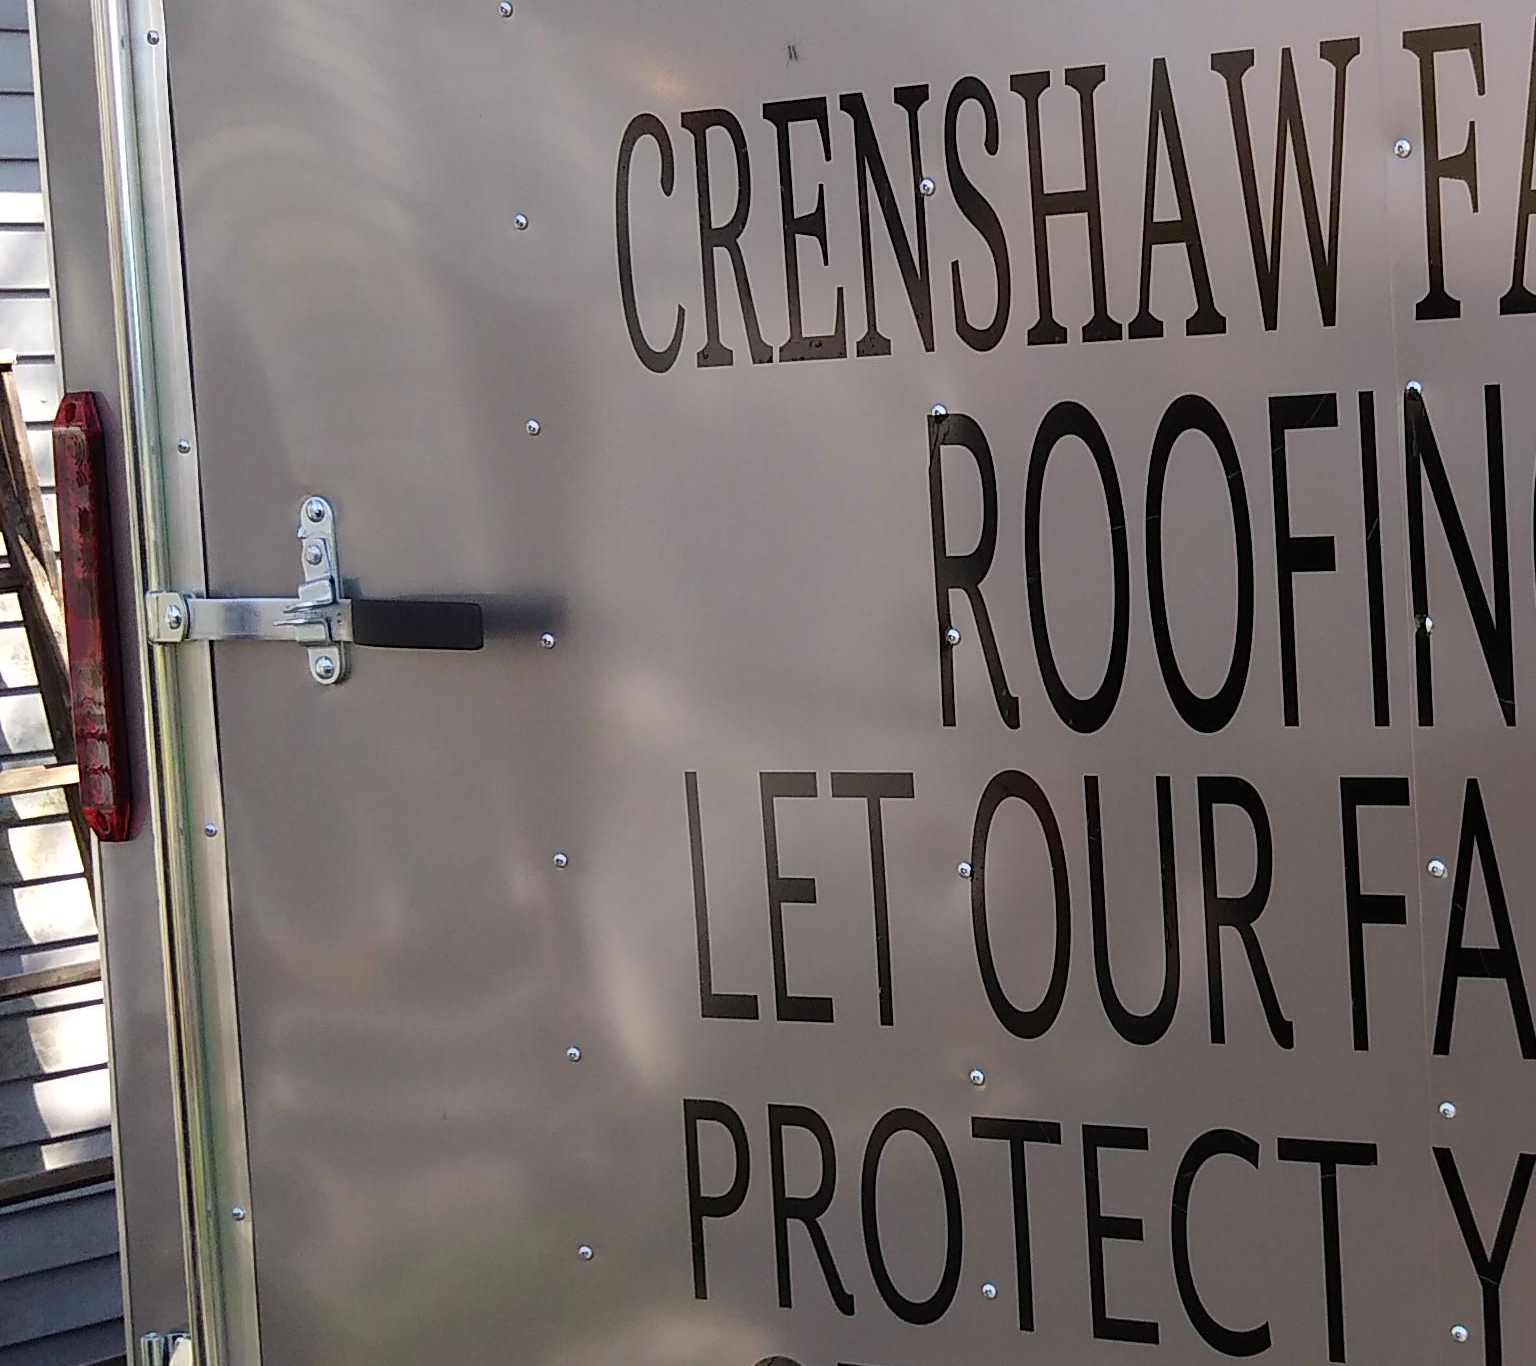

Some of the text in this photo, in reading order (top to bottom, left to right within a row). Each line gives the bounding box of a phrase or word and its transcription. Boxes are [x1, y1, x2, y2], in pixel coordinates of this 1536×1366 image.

[615, 36, 1361, 374] CRENSHAW
[684, 771, 916, 1027] LET
[965, 769, 1295, 1051] OUR
[683, 1098, 1379, 1365] PROTECT
